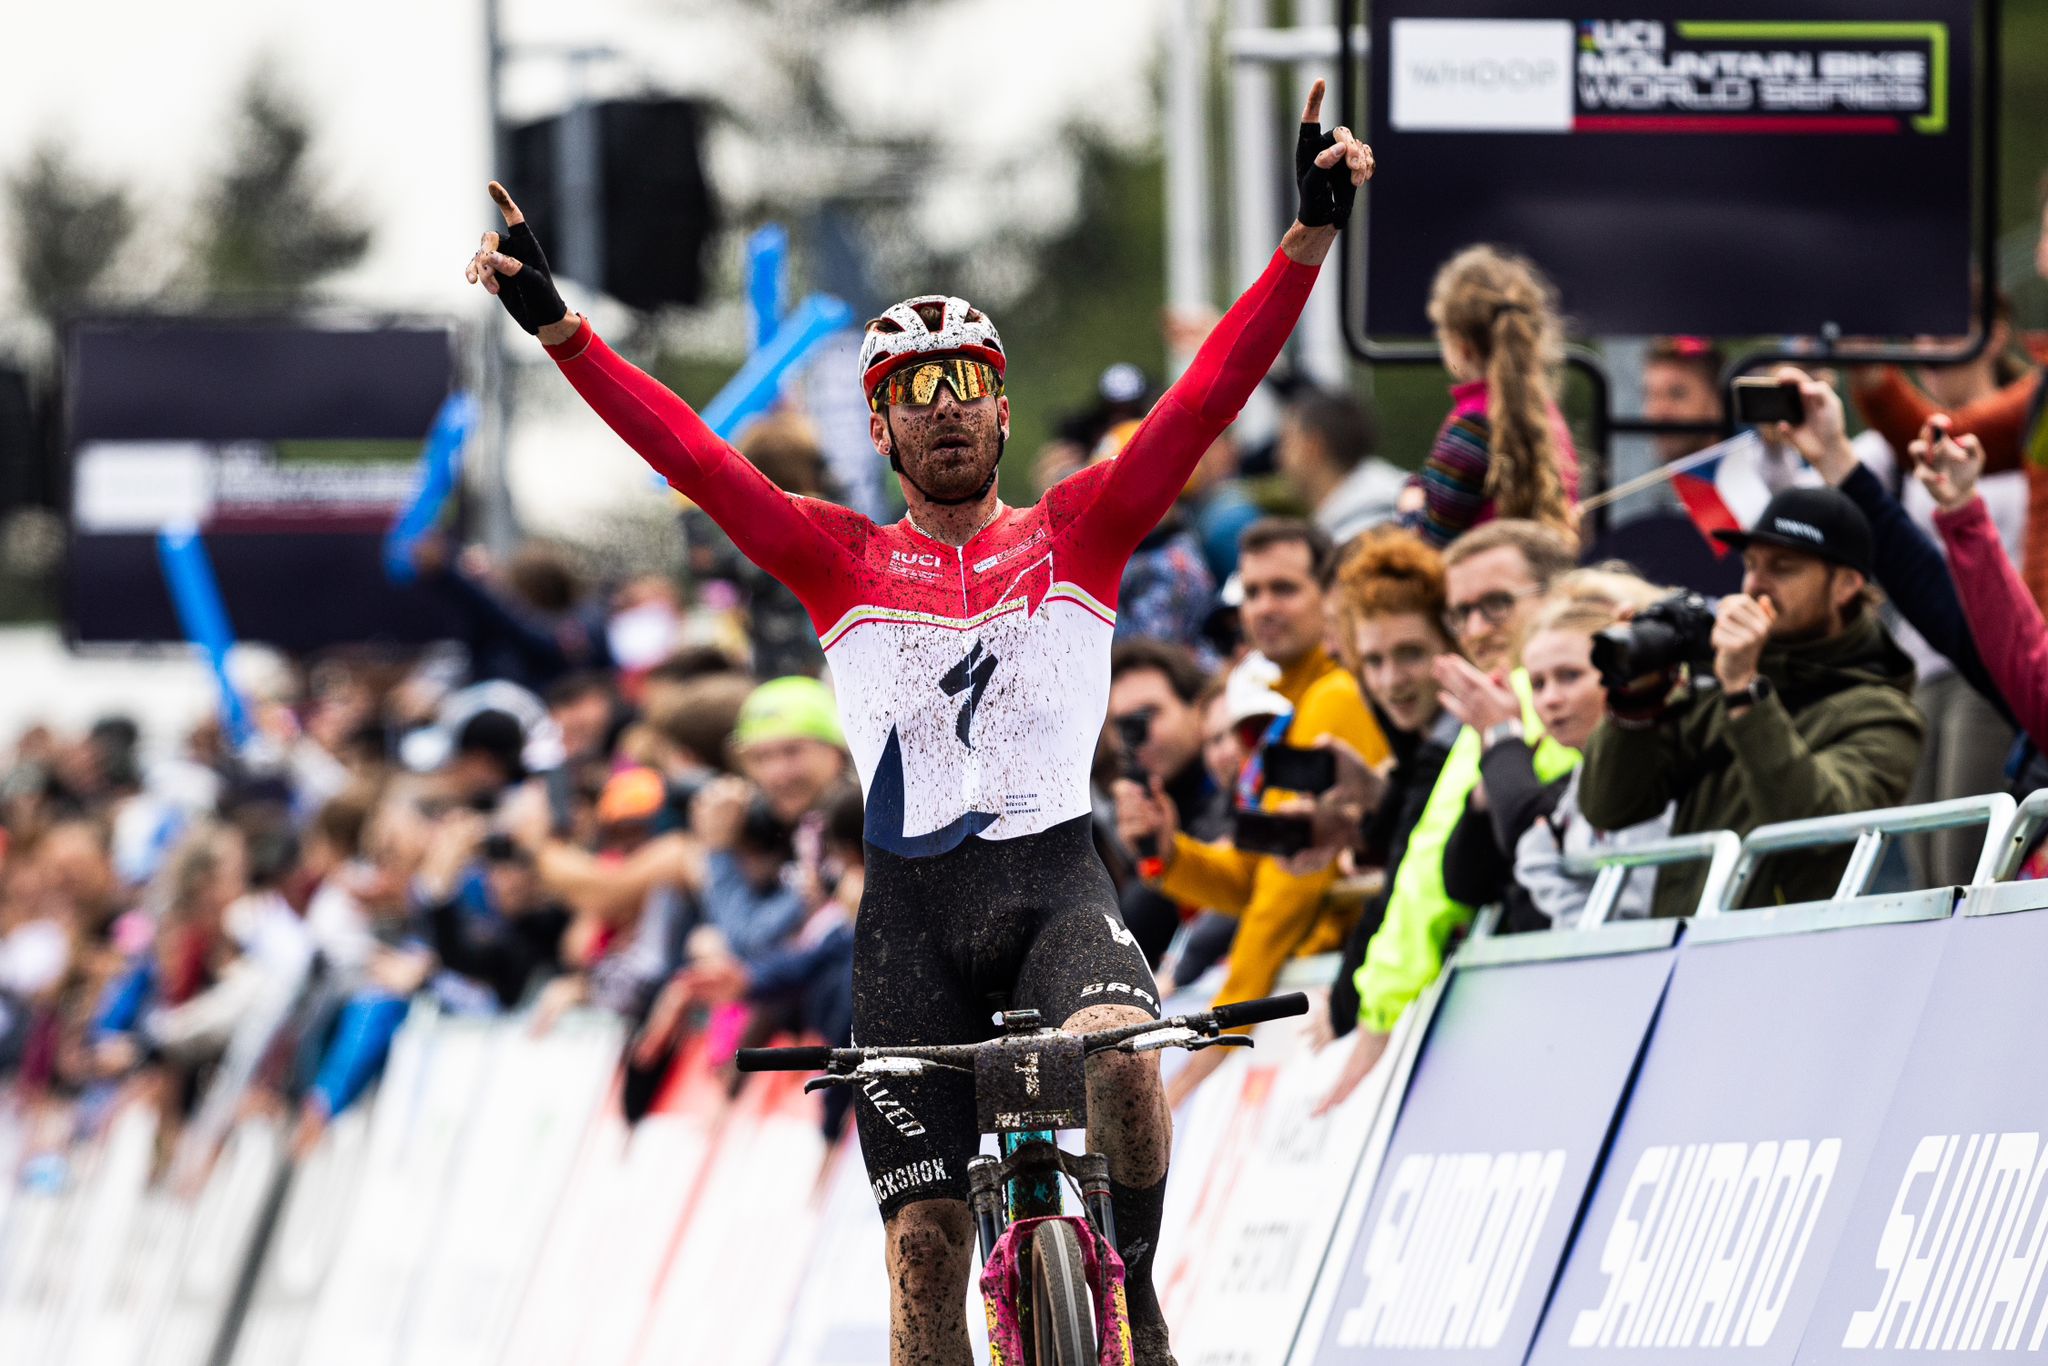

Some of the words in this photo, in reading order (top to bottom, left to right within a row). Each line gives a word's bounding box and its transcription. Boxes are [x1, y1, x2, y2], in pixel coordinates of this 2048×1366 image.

[1594, 19, 1665, 50] UCI
[1410, 56, 1559, 94] WHOOP
[1579, 50, 1813, 78] MOUNTAIN
[1818, 50, 1926, 78] BIKE
[1579, 76, 1753, 110] WORLD
[1760, 77, 1927, 111] SERIES
[901, 551, 941, 568] UCI
[1080, 982, 1161, 1014] SRA
[1568, 1138, 1842, 1347] SHIMANO
